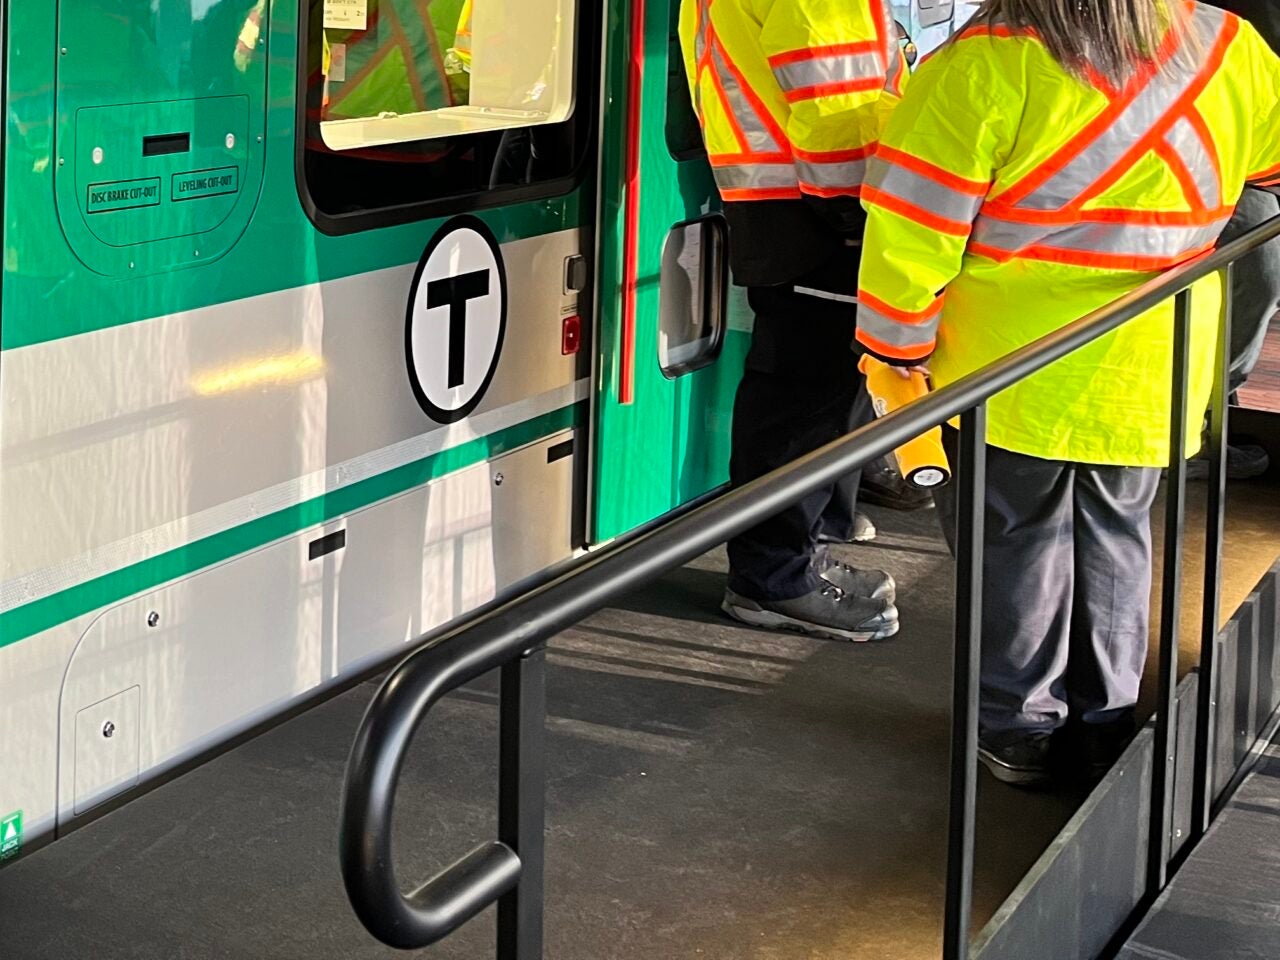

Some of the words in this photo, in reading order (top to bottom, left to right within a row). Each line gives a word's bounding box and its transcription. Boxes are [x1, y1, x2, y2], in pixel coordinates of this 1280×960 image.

[178, 178, 207, 192] LEVELING
[208, 175, 232, 188] CUT-OUT
[91, 191, 107, 204] DISC
[107, 189, 129, 202] BRAKE
[130, 186, 157, 200] CUT-OUT
[427, 268, 490, 389] T
